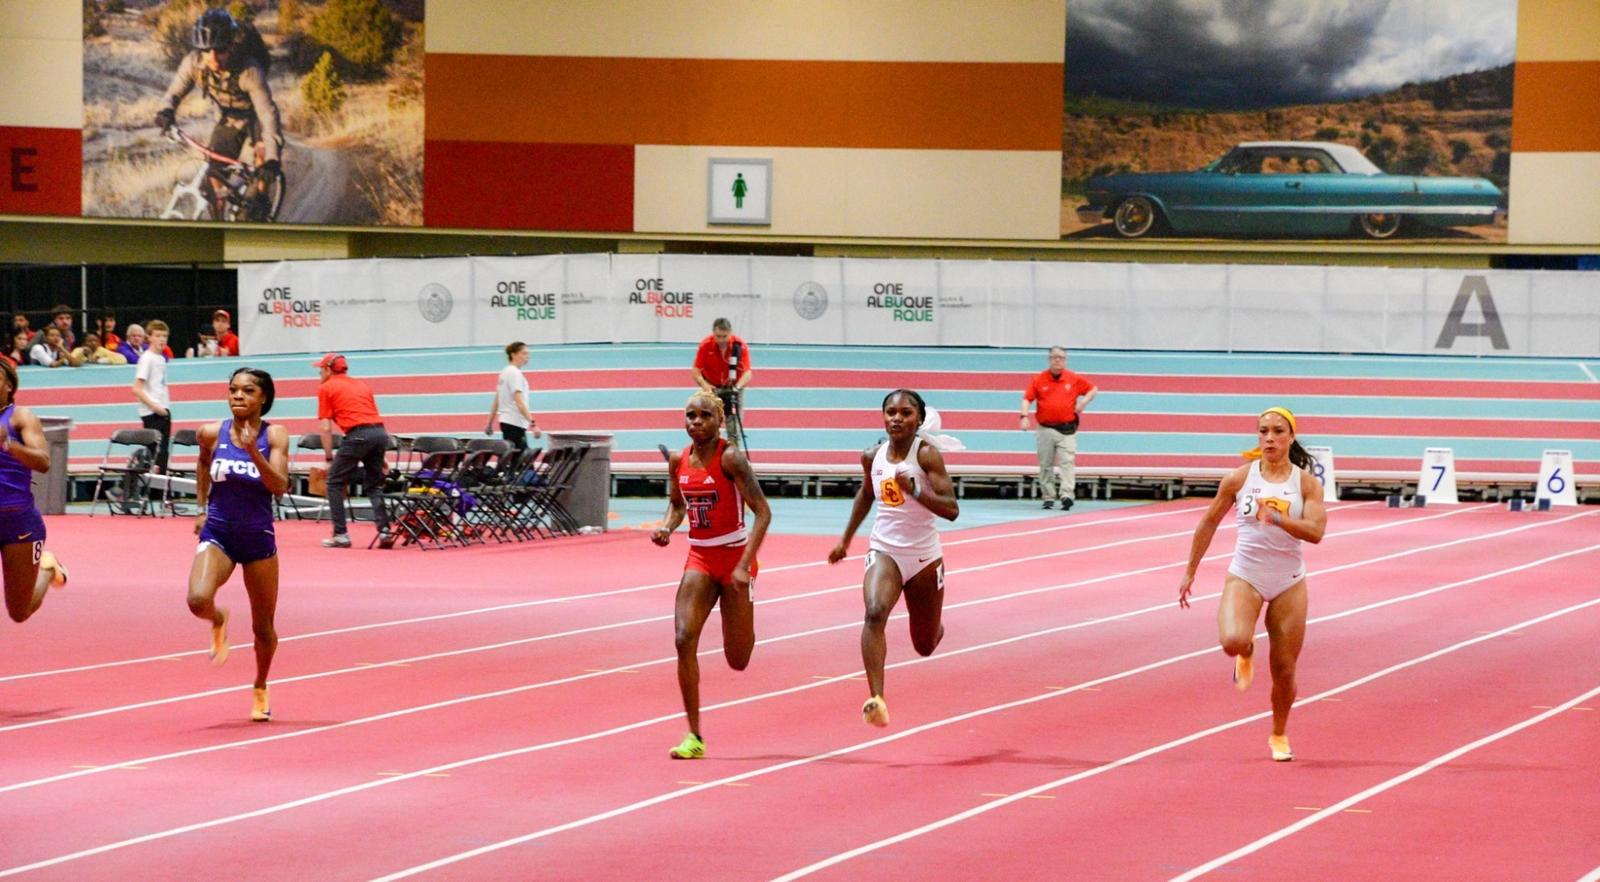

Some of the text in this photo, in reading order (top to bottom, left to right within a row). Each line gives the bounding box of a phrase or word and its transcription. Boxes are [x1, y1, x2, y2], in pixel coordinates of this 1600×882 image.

[11, 147, 38, 192] E
[497, 280, 526, 294] ONE
[636, 278, 664, 291] ONE
[873, 282, 904, 295] ONE
[263, 287, 292, 301] ONE
[491, 293, 556, 307] ALBUQUE
[629, 291, 694, 305] ALBUQUE
[258, 300, 321, 315] ALBUQUE
[867, 296, 933, 309] ALBUQUE
[517, 306, 556, 320] RQUE
[655, 304, 694, 318] RQUE
[894, 308, 933, 322] RQUE
[1434, 275, 1511, 350] A
[283, 313, 321, 328] RQUE
[1431, 465, 1446, 492] 7
[1547, 467, 1565, 494] 6
[1243, 494, 1254, 516] 3
[35, 541, 42, 561] 8
